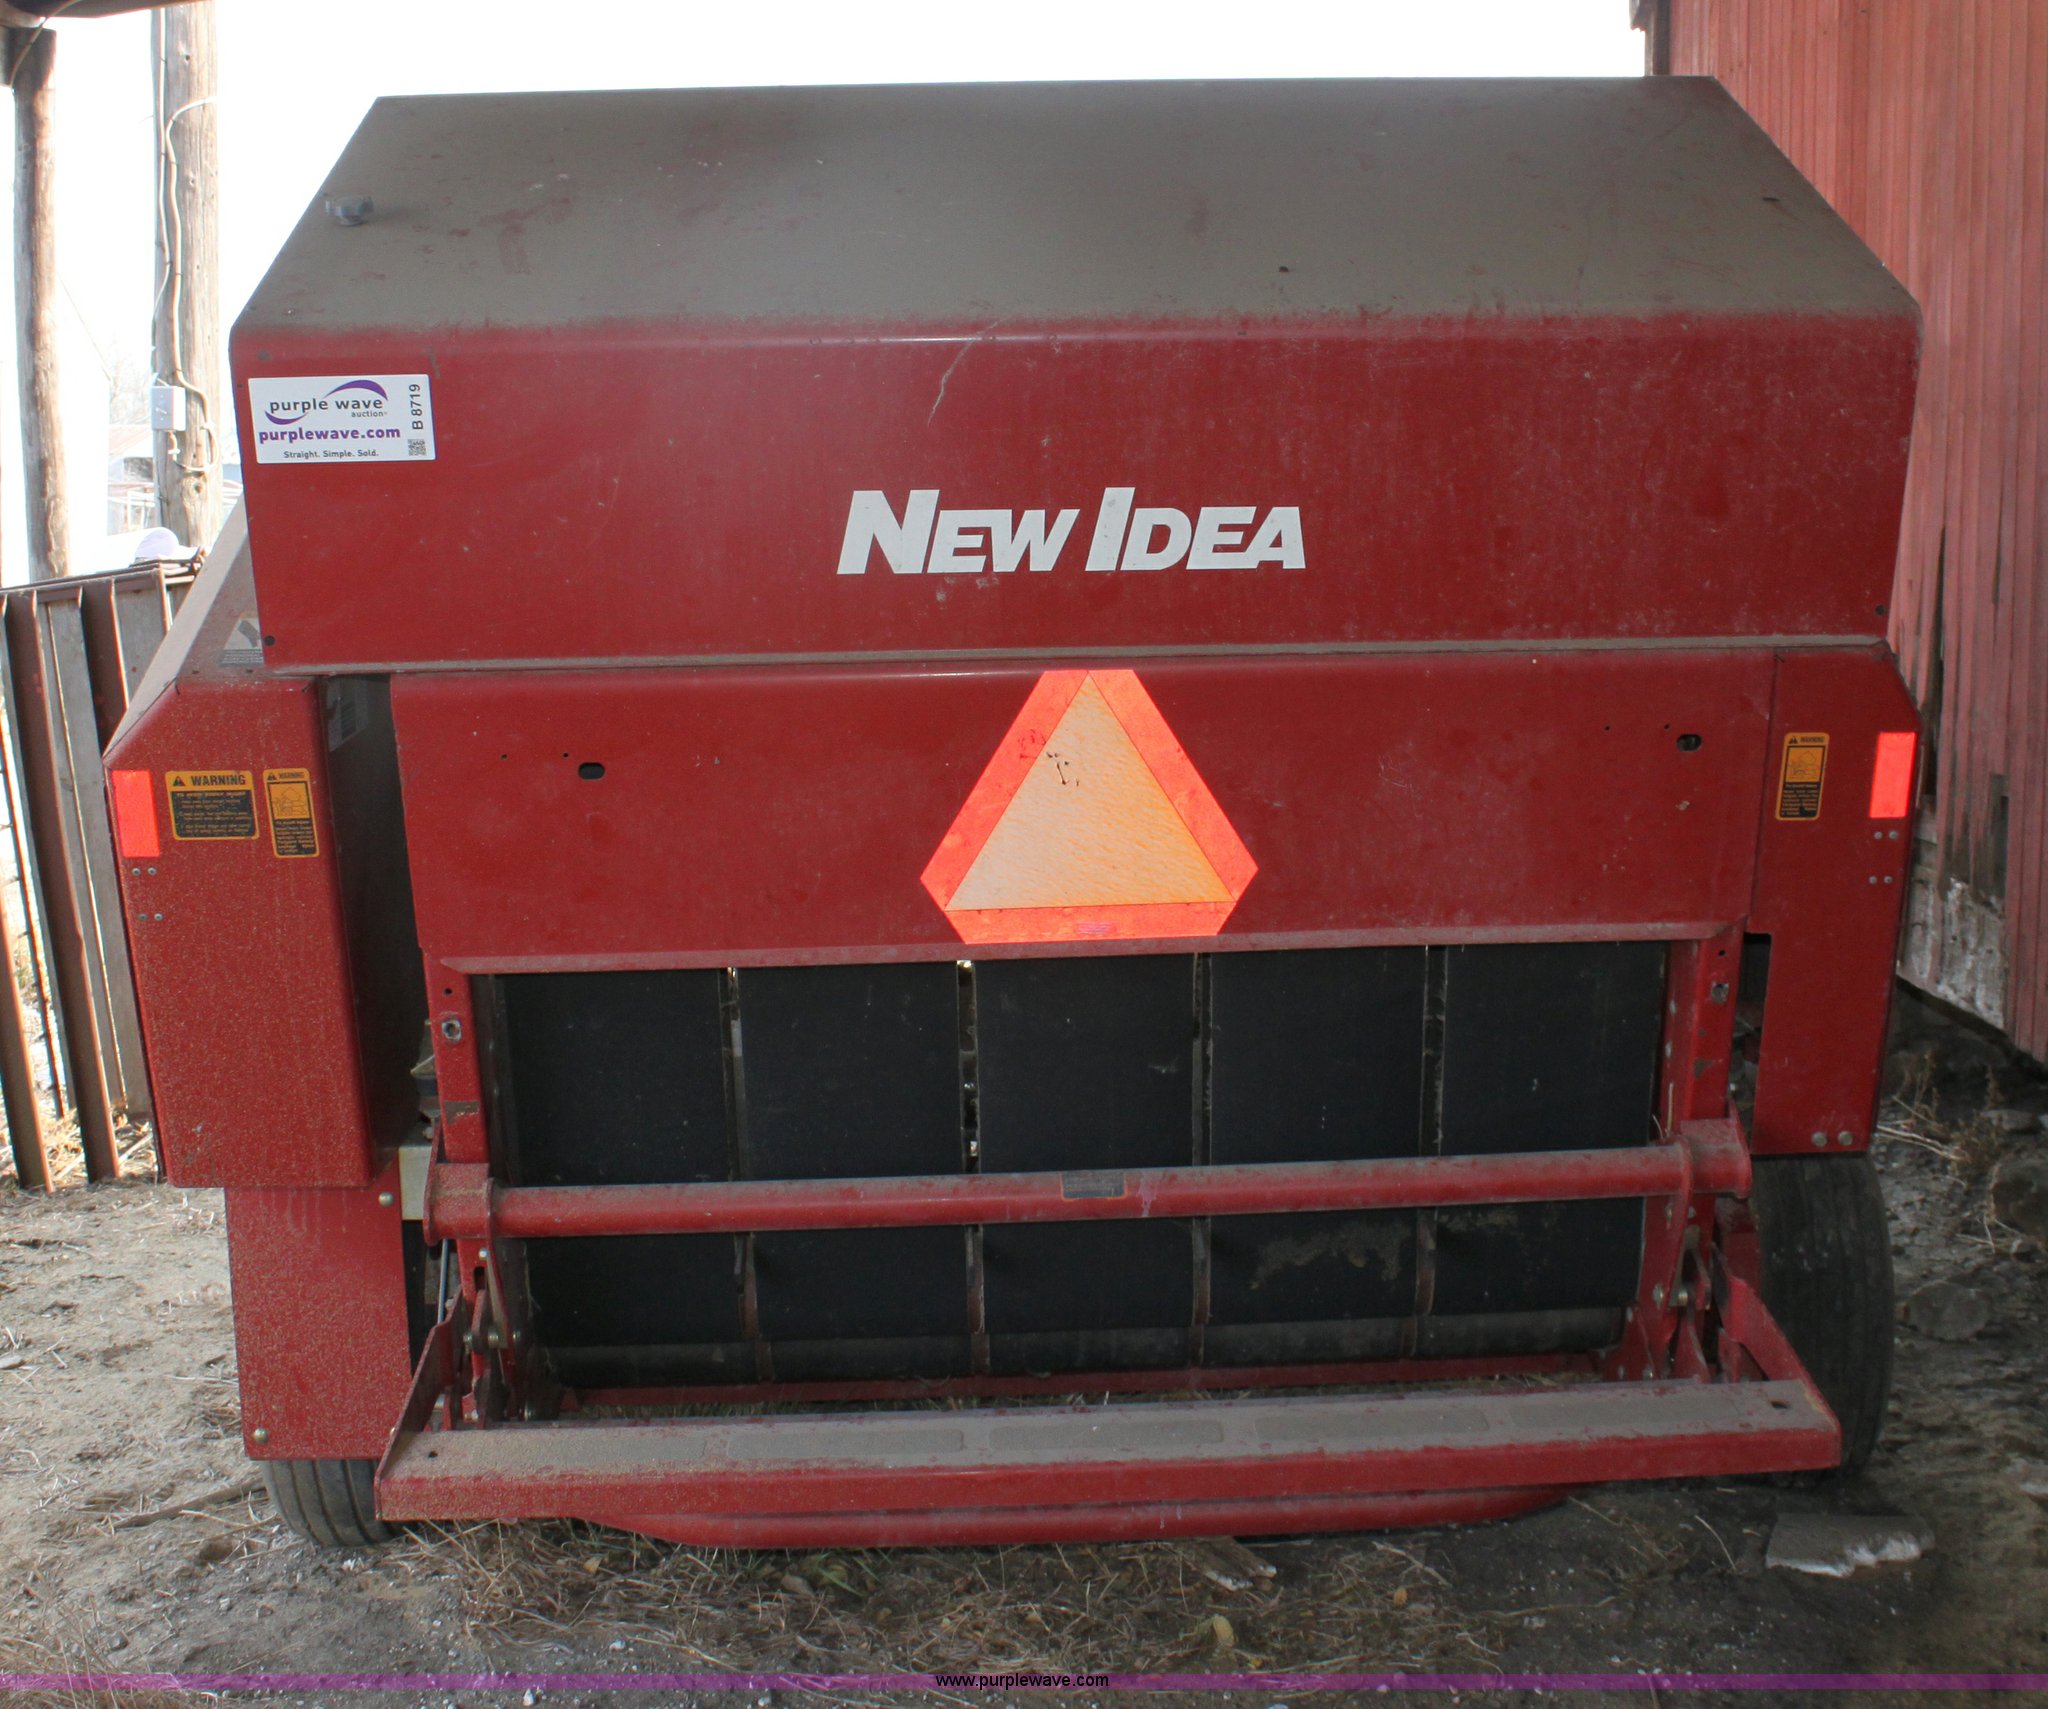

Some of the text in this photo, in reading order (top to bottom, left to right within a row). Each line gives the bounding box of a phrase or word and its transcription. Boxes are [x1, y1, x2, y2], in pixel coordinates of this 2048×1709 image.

[270, 398, 383, 414] purple wave
[408, 383, 424, 430] B 8719
[259, 426, 401, 444] purplewave.com
[283, 449, 379, 459] Straight. Simple. Sold.
[837, 487, 1306, 575] NEW IDEA
[190, 774, 246, 787] WARNING
